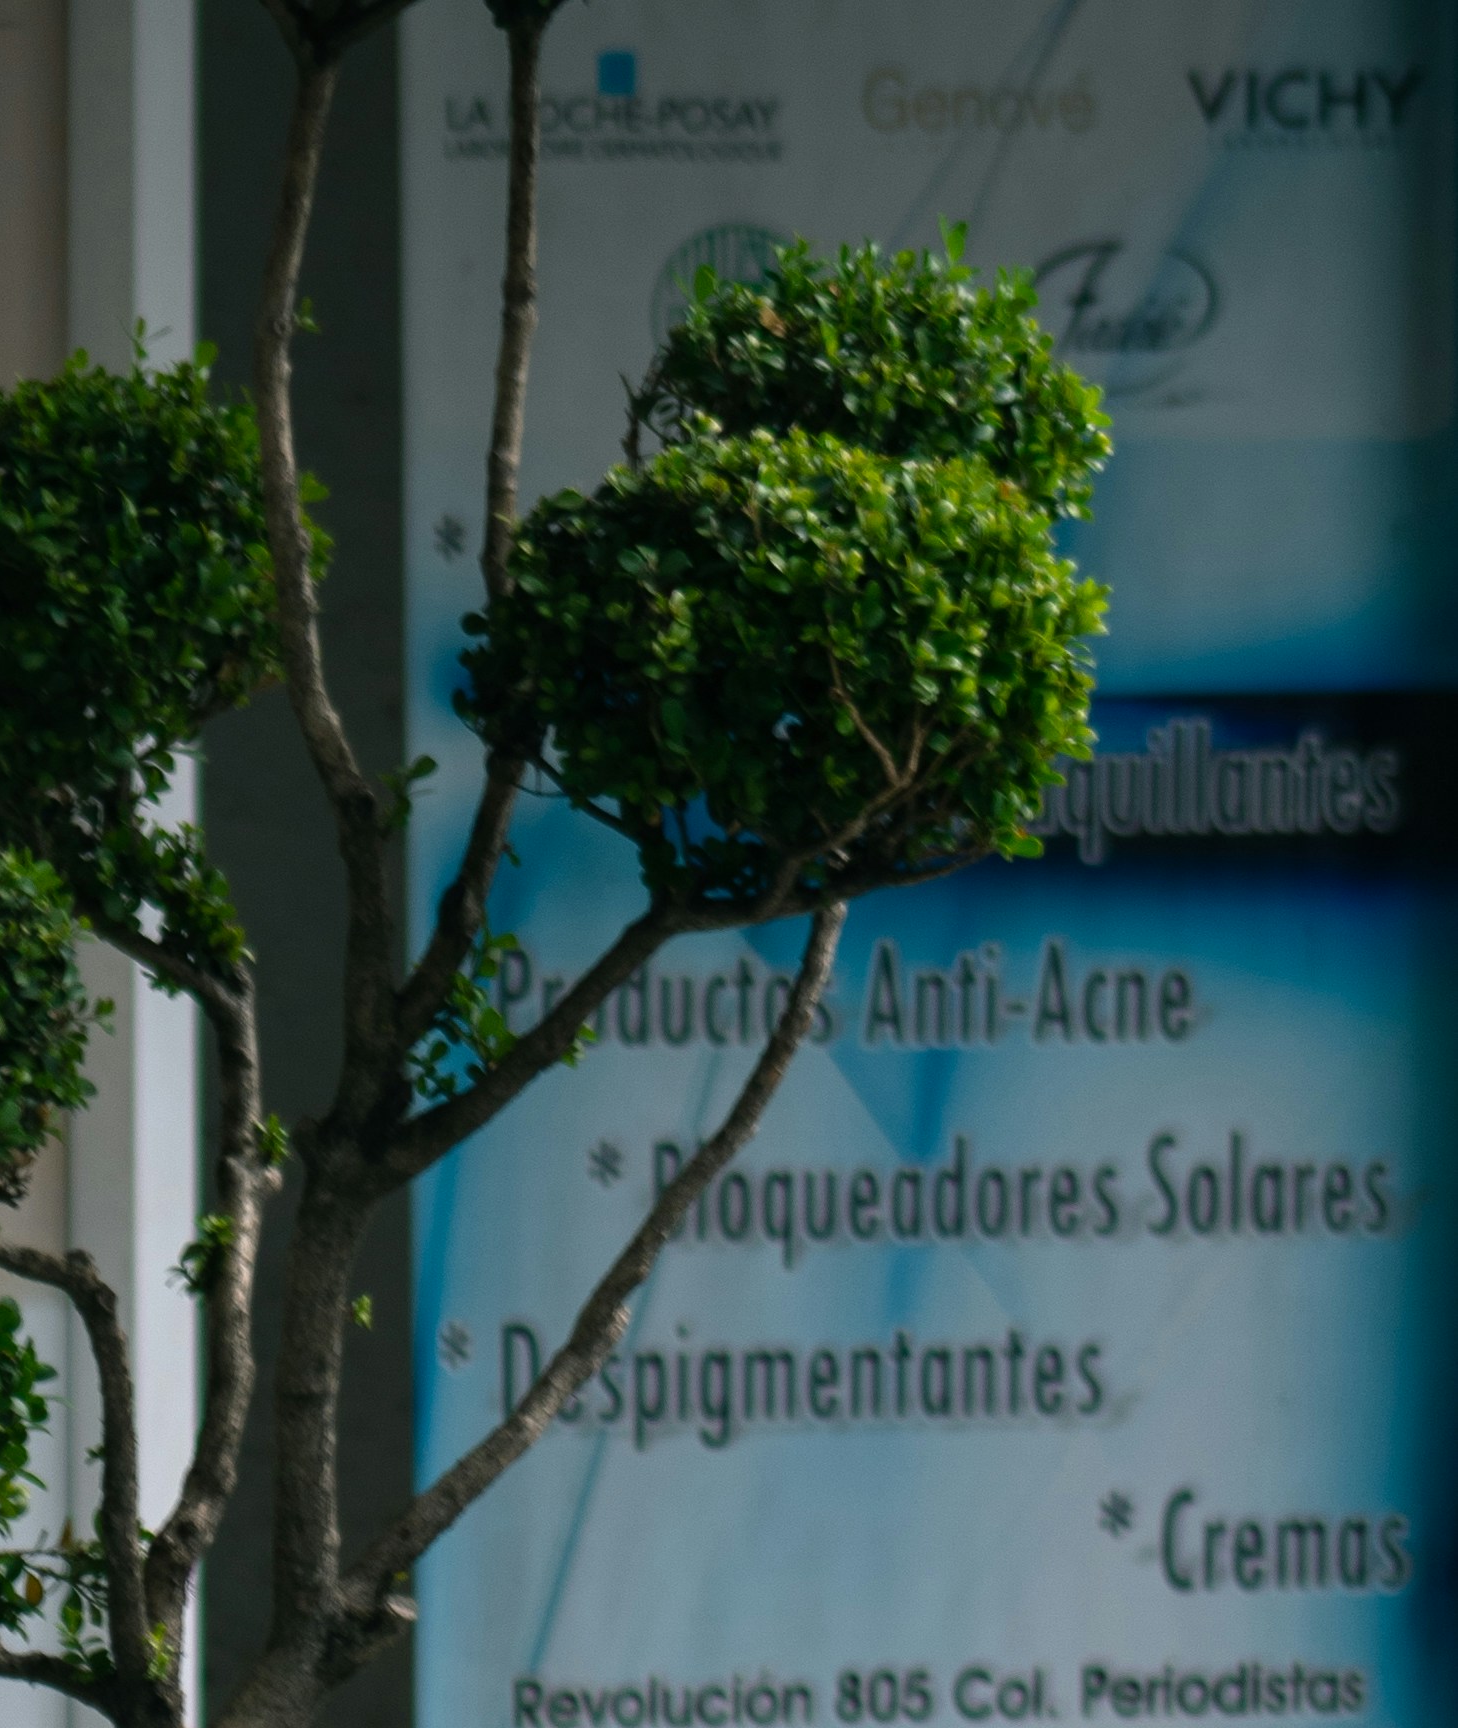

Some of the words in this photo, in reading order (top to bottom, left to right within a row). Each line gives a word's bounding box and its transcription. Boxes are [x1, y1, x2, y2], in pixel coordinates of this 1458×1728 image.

[445, 97, 490, 133] LA
[538, 97, 781, 134] OCHE-POSAY
[860, 66, 1098, 135] Genové
[1186, 66, 1427, 131] VICHY
[1026, 716, 1400, 864] quillantes
[499, 948, 836, 1047] Prductos
[866, 938, 1193, 1048] Anti-Acne
[1146, 1133, 1390, 1238] Solares
[1160, 1487, 1410, 1592] Cremas
[835, 1670, 933, 1724] 805
[953, 1669, 1057, 1721] Col.
[1080, 1665, 1366, 1720] Periodistas
